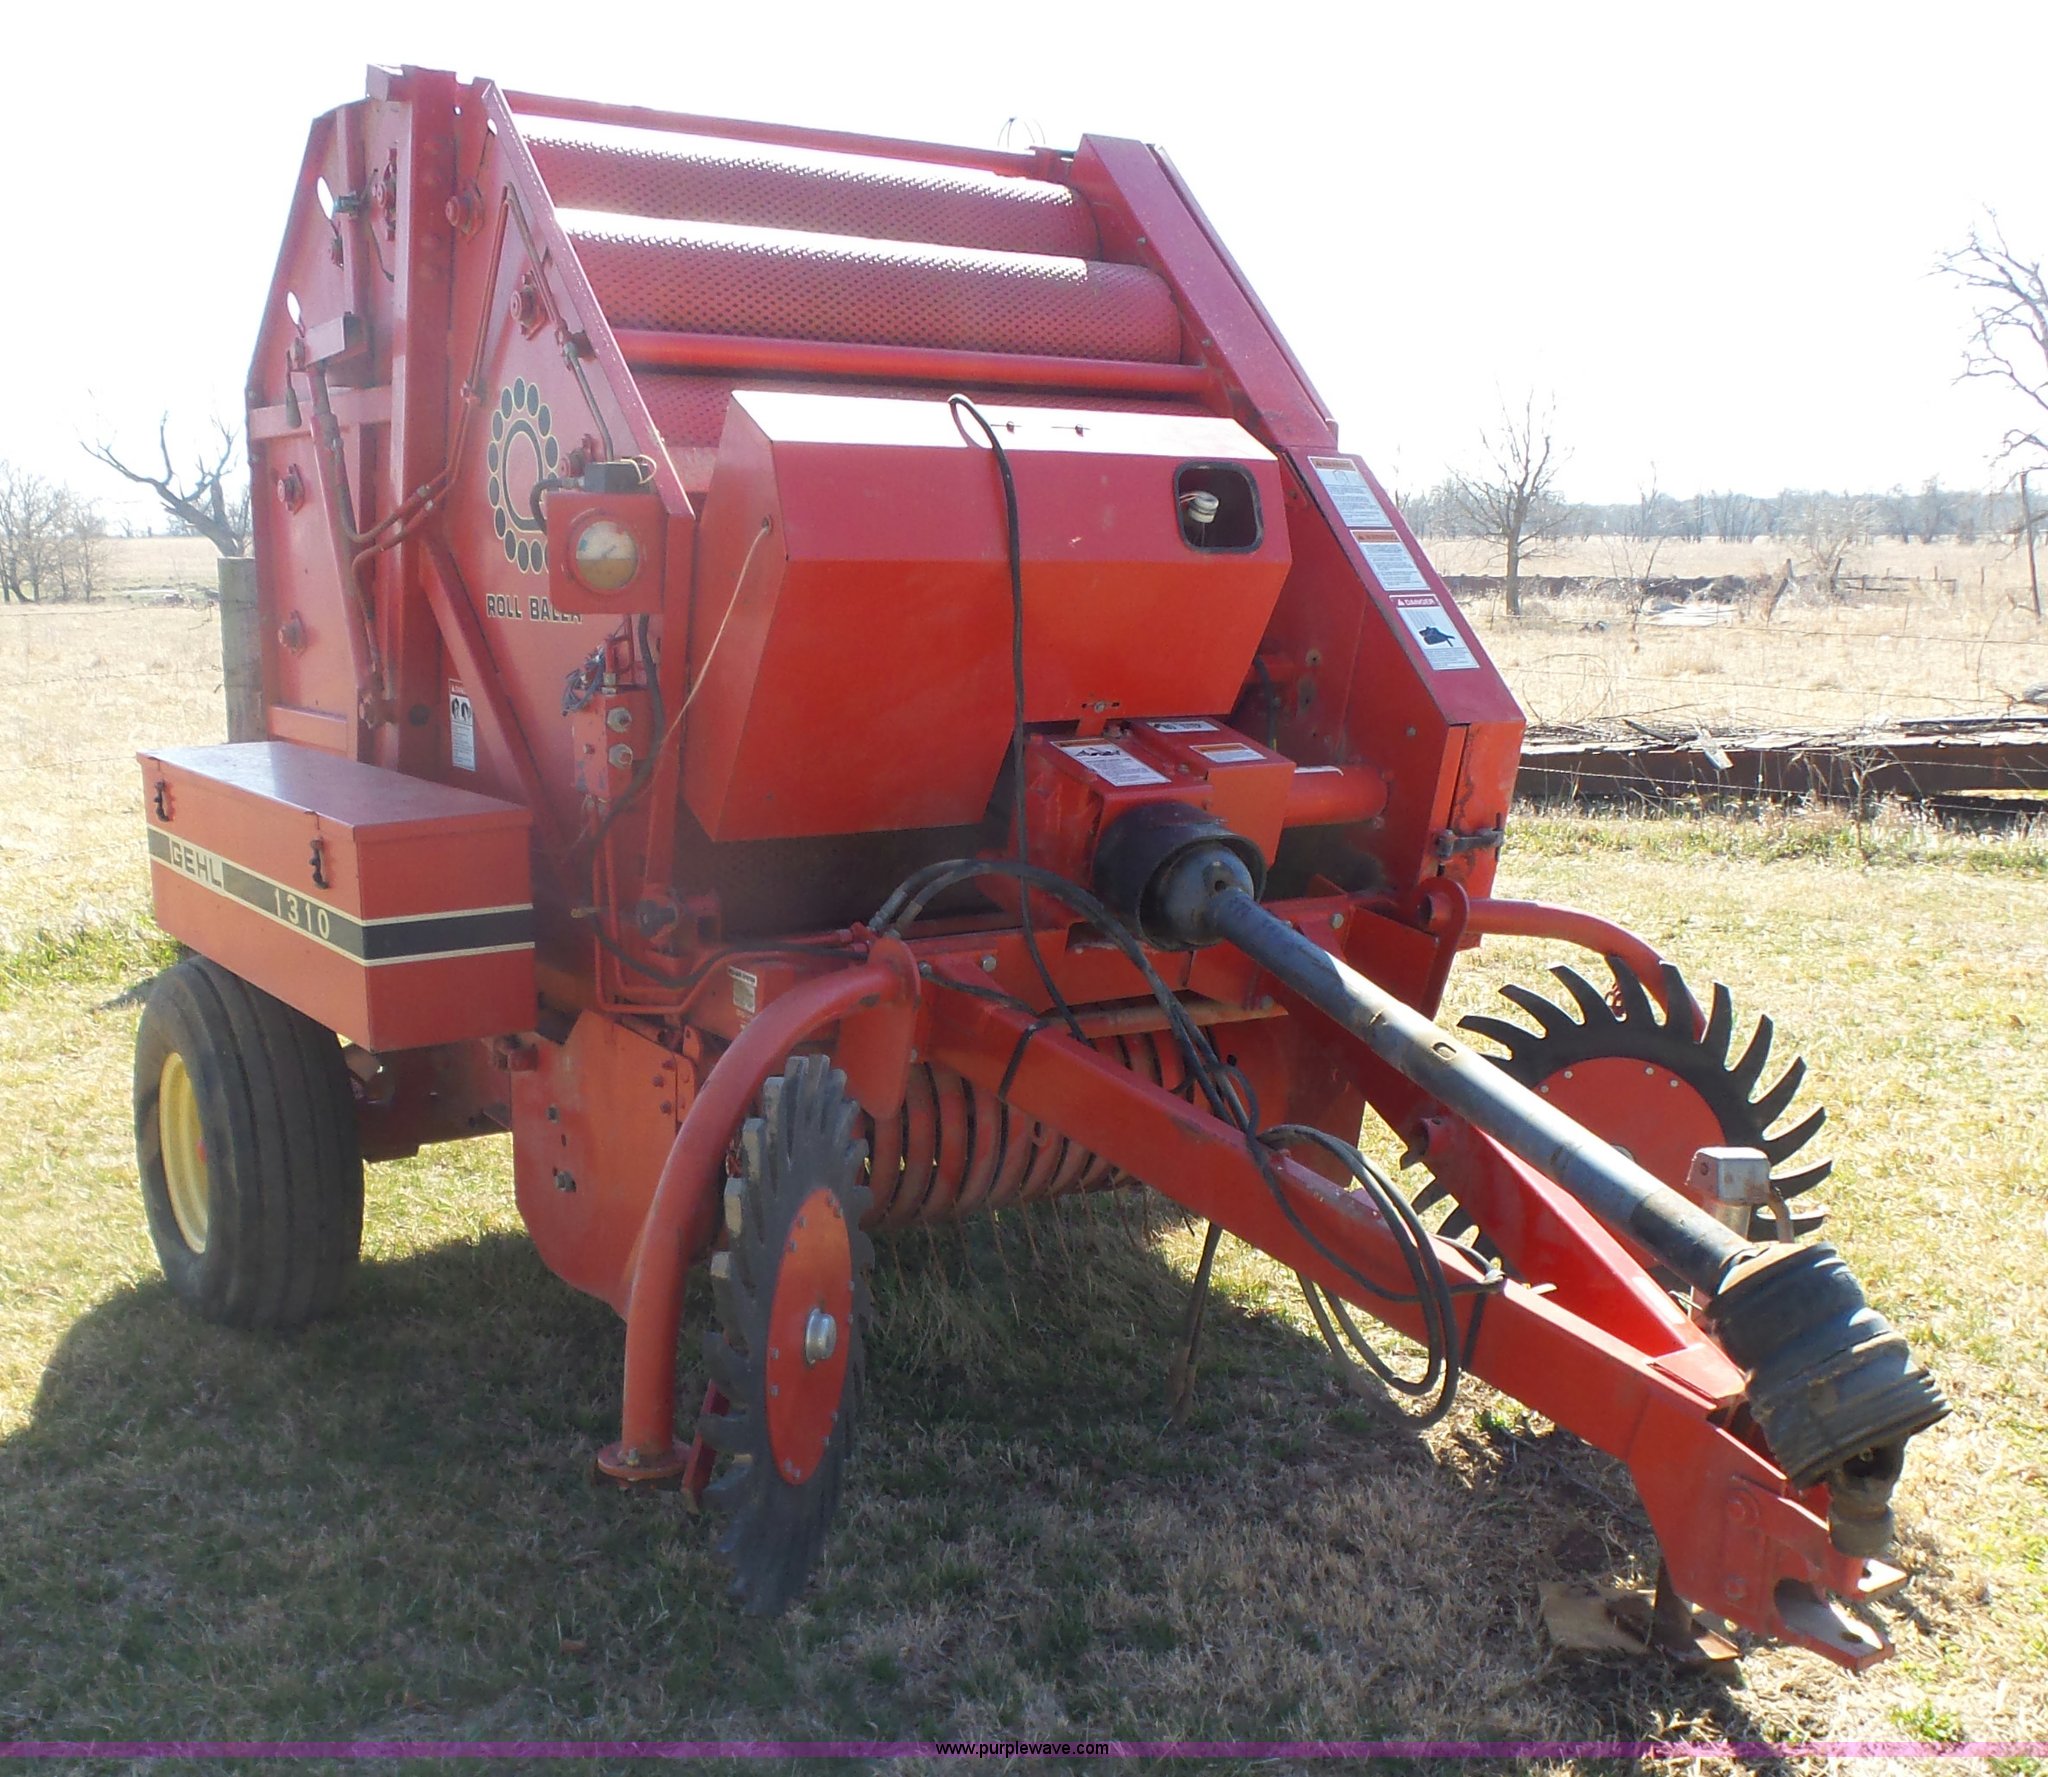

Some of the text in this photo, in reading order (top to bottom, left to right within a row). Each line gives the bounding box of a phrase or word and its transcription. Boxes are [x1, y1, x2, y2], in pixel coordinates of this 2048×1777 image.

[486, 594, 522, 620] ROLL
[171, 840, 222, 888] GEHL
[275, 888, 330, 940] 1310
